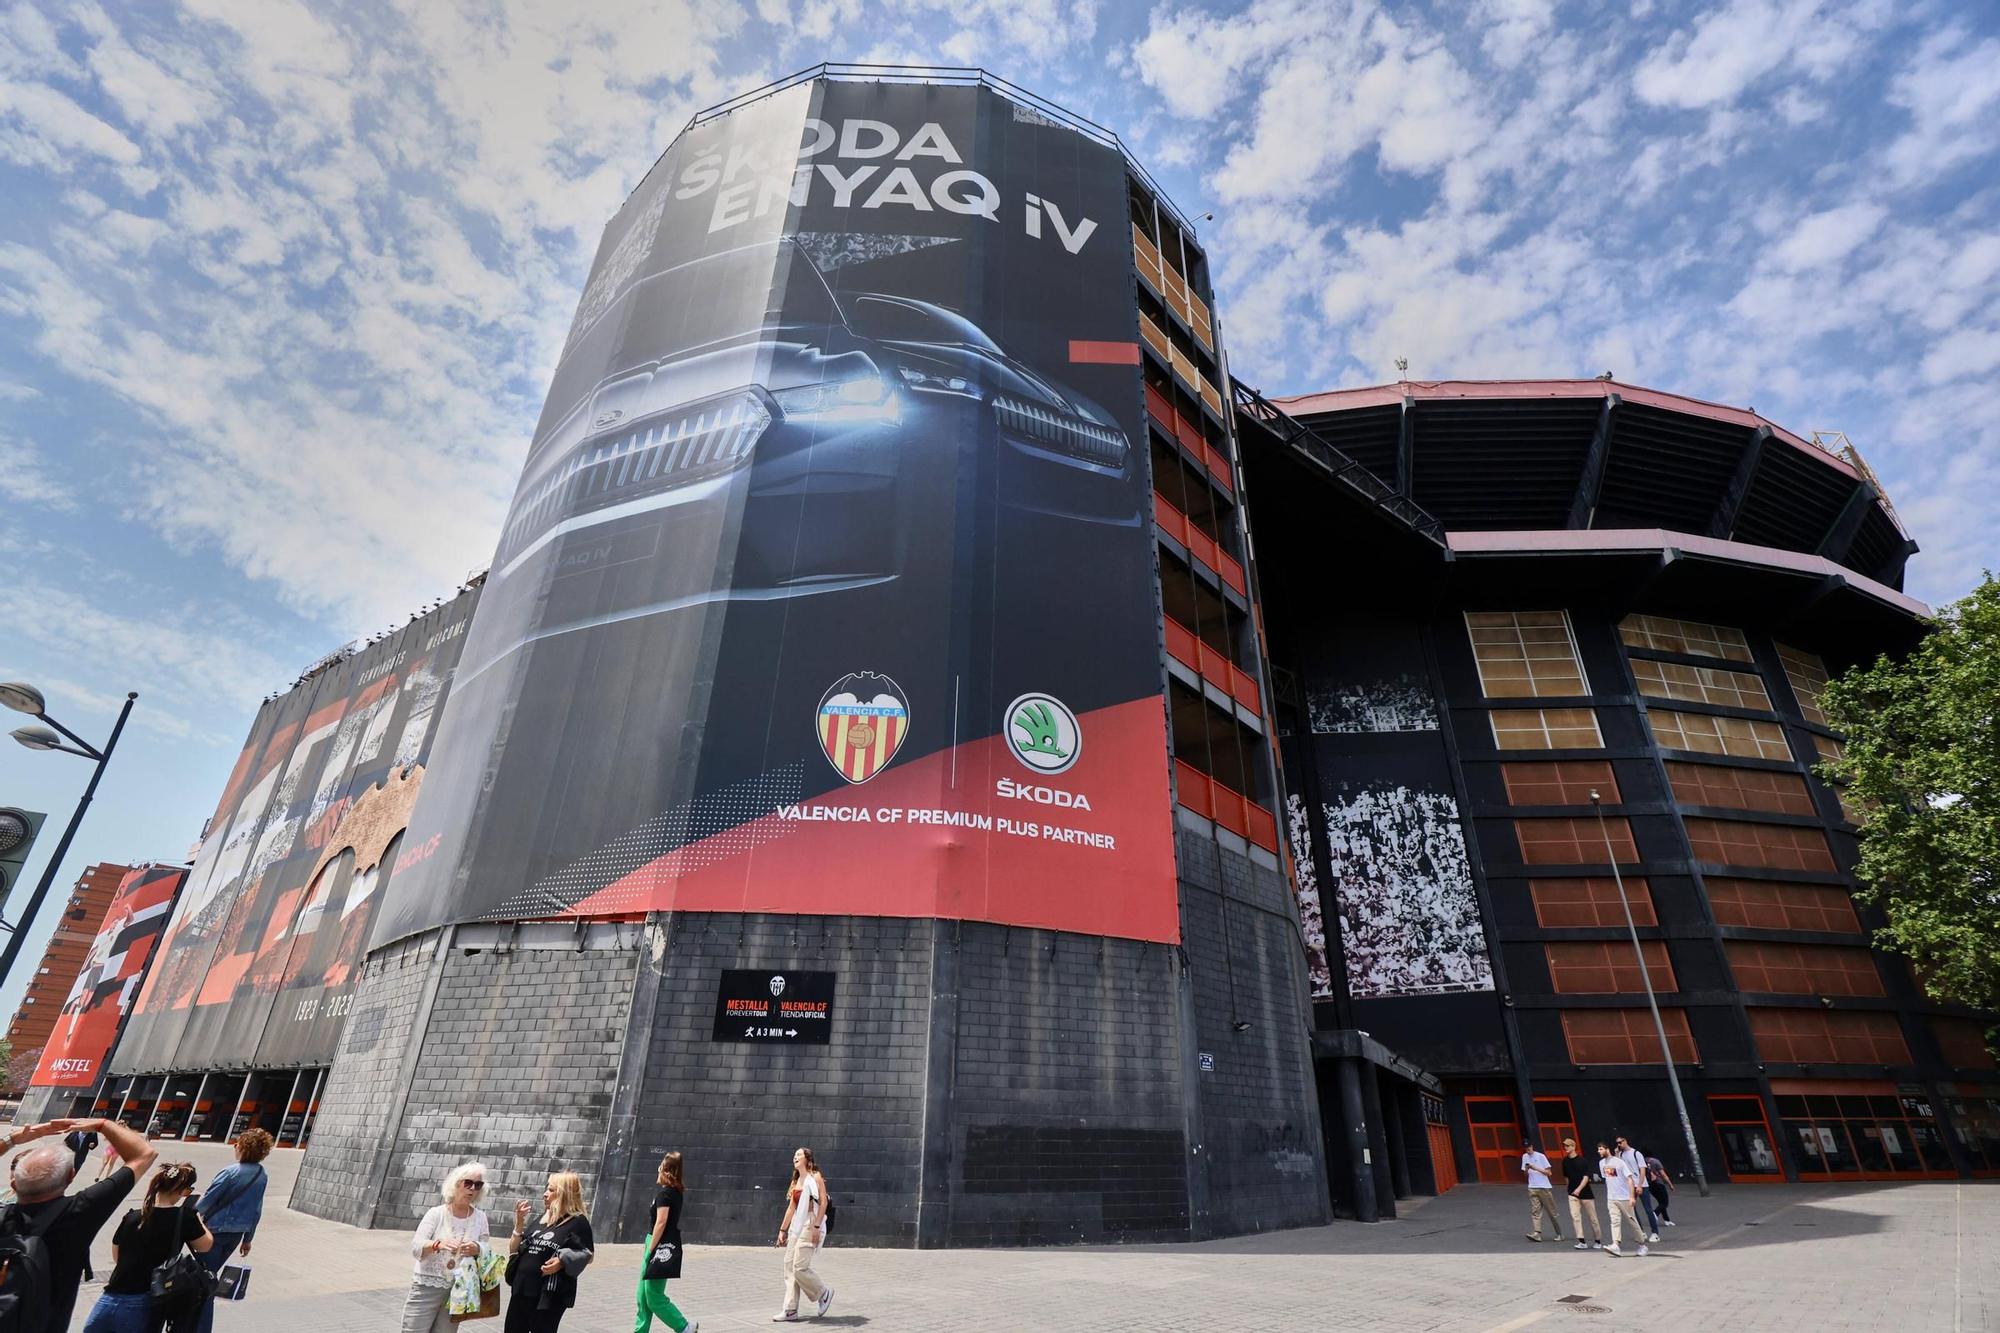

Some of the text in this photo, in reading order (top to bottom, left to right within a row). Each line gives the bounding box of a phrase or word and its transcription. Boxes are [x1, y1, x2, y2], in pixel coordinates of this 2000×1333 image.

[674, 118, 963, 202] ŠKODA
[707, 164, 1099, 255] ENYAQ iV
[425, 617, 468, 652] WELCOME
[825, 707, 880, 716] VALENCIA
[996, 776, 1092, 812] ŠKODA
[776, 804, 1116, 850] VALENCIA CF PREMIUM PLUS PARTNER
[294, 994, 353, 1022] 1923 2023
[727, 999, 768, 1010] MESTALLA
[780, 1001, 828, 1012] VALENCIA CF
[804, 1011, 826, 1019] OFICIAL
[756, 1028, 783, 1038] A 3 MIN
[50, 1058, 91, 1072] AMSTEL
